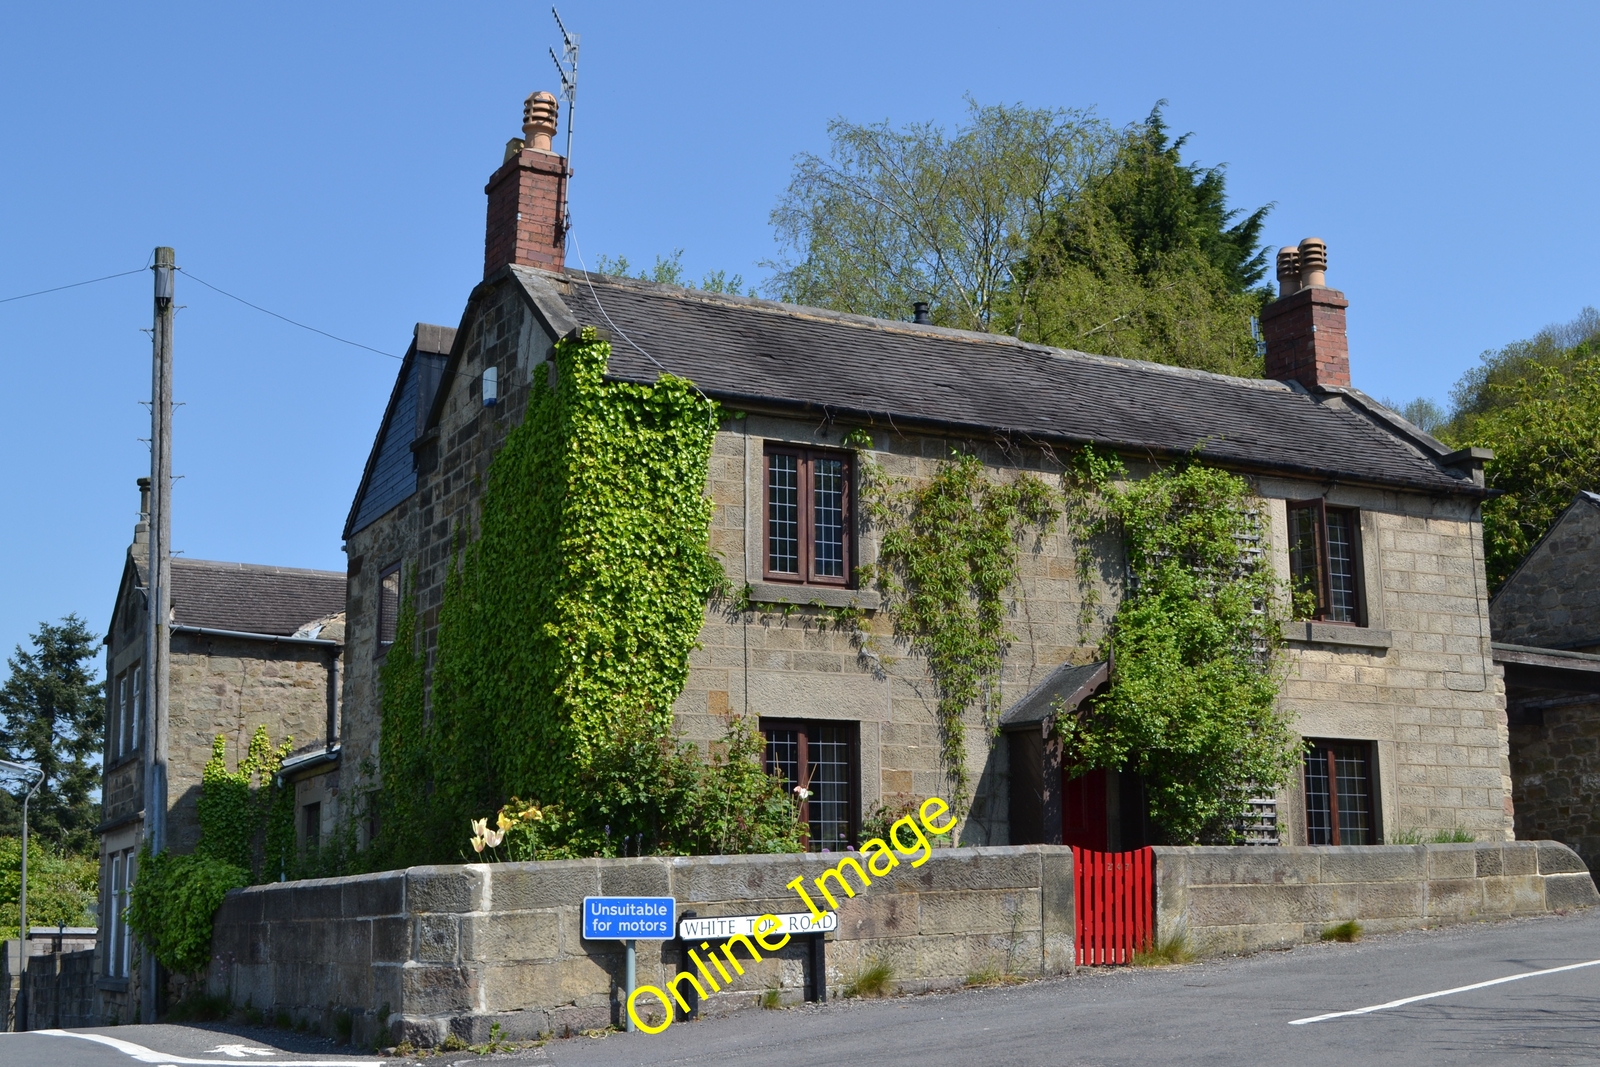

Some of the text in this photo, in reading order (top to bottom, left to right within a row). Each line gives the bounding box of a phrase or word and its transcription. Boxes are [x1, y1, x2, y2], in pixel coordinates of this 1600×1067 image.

[591, 903, 668, 916] Unsuitable
[592, 919, 667, 931] for motors
[685, 919, 736, 936] WHITE
[789, 915, 833, 930] ROAD
